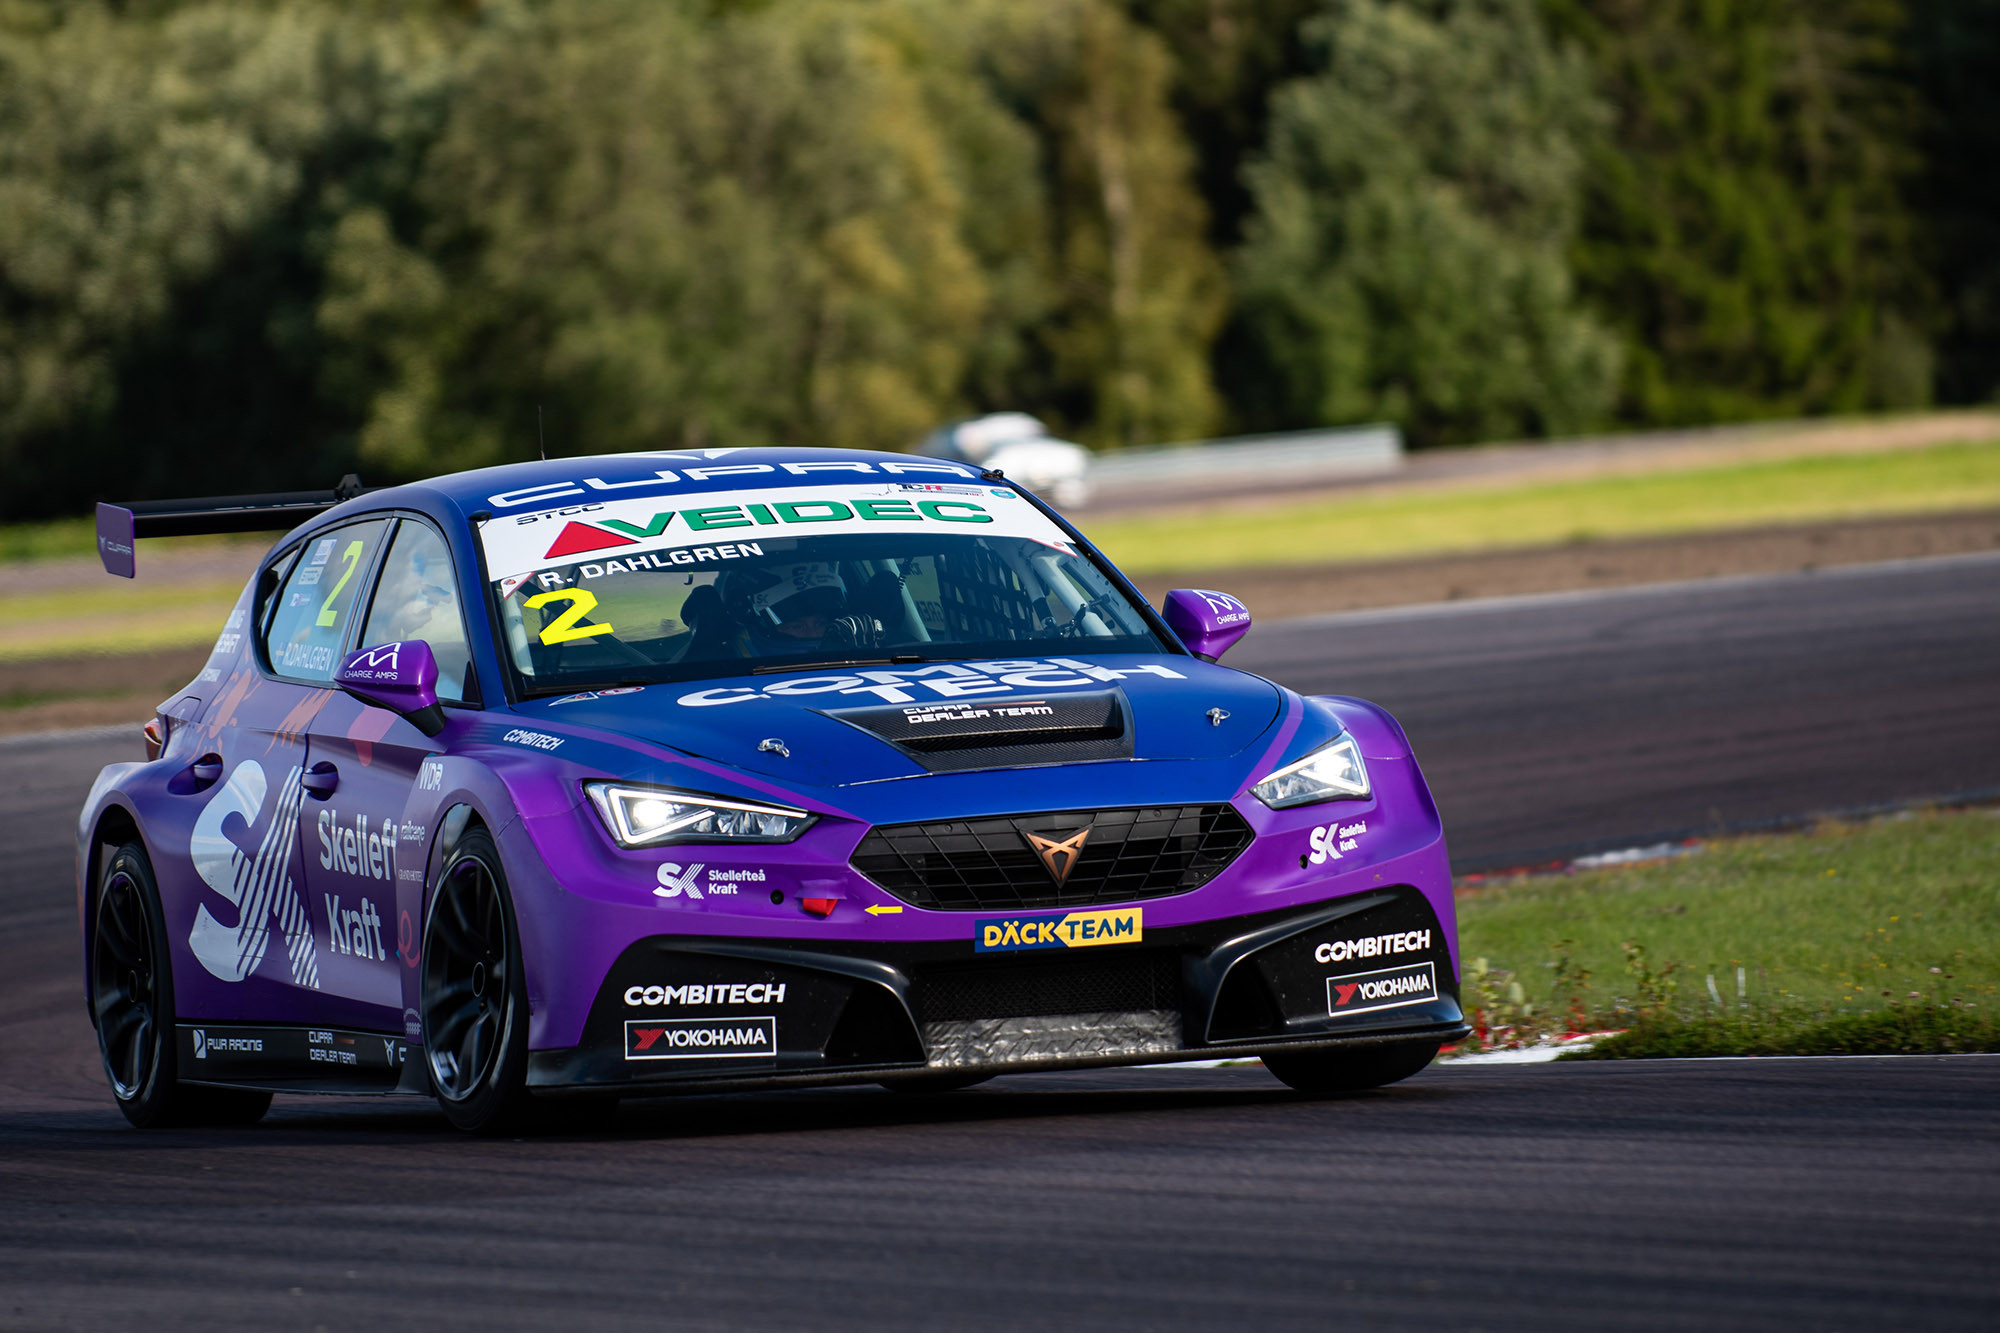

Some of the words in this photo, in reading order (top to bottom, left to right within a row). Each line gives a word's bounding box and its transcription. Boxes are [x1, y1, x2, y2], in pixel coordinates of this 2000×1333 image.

[487, 462, 976, 508] CUPRA
[516, 502, 604, 526] STCC
[596, 499, 994, 538] VEIDEC
[537, 571, 574, 587] R.
[579, 542, 764, 579] DAHLGREN
[523, 587, 615, 646] 2
[344, 670, 373, 679] CHARGE
[375, 671, 398, 680] AMPS
[677, 658, 1094, 707] COMBI
[840, 664, 1188, 704] TECH
[902, 703, 972, 715] CUPRA
[907, 709, 990, 724] DEALER
[993, 706, 1054, 717] TEAM
[502, 728, 565, 751] COMBITECH
[708, 869, 766, 881] Skellefteå
[708, 883, 738, 895] Kraft
[324, 892, 386, 962] Kraft
[983, 920, 1055, 947] DÄCK
[1065, 916, 1134, 941] TEAM
[1315, 929, 1431, 963] COMBITECH
[624, 983, 787, 1006] COMBITECH
[1357, 973, 1431, 1000] YOKOHAMA
[207, 1038, 227, 1050] PWR
[228, 1038, 263, 1051] RACING
[308, 1031, 334, 1044] CUPRA
[664, 1027, 768, 1048] YOKOHAMA
[309, 1048, 338, 1063] DEALER
[338, 1051, 358, 1065] TEAM
